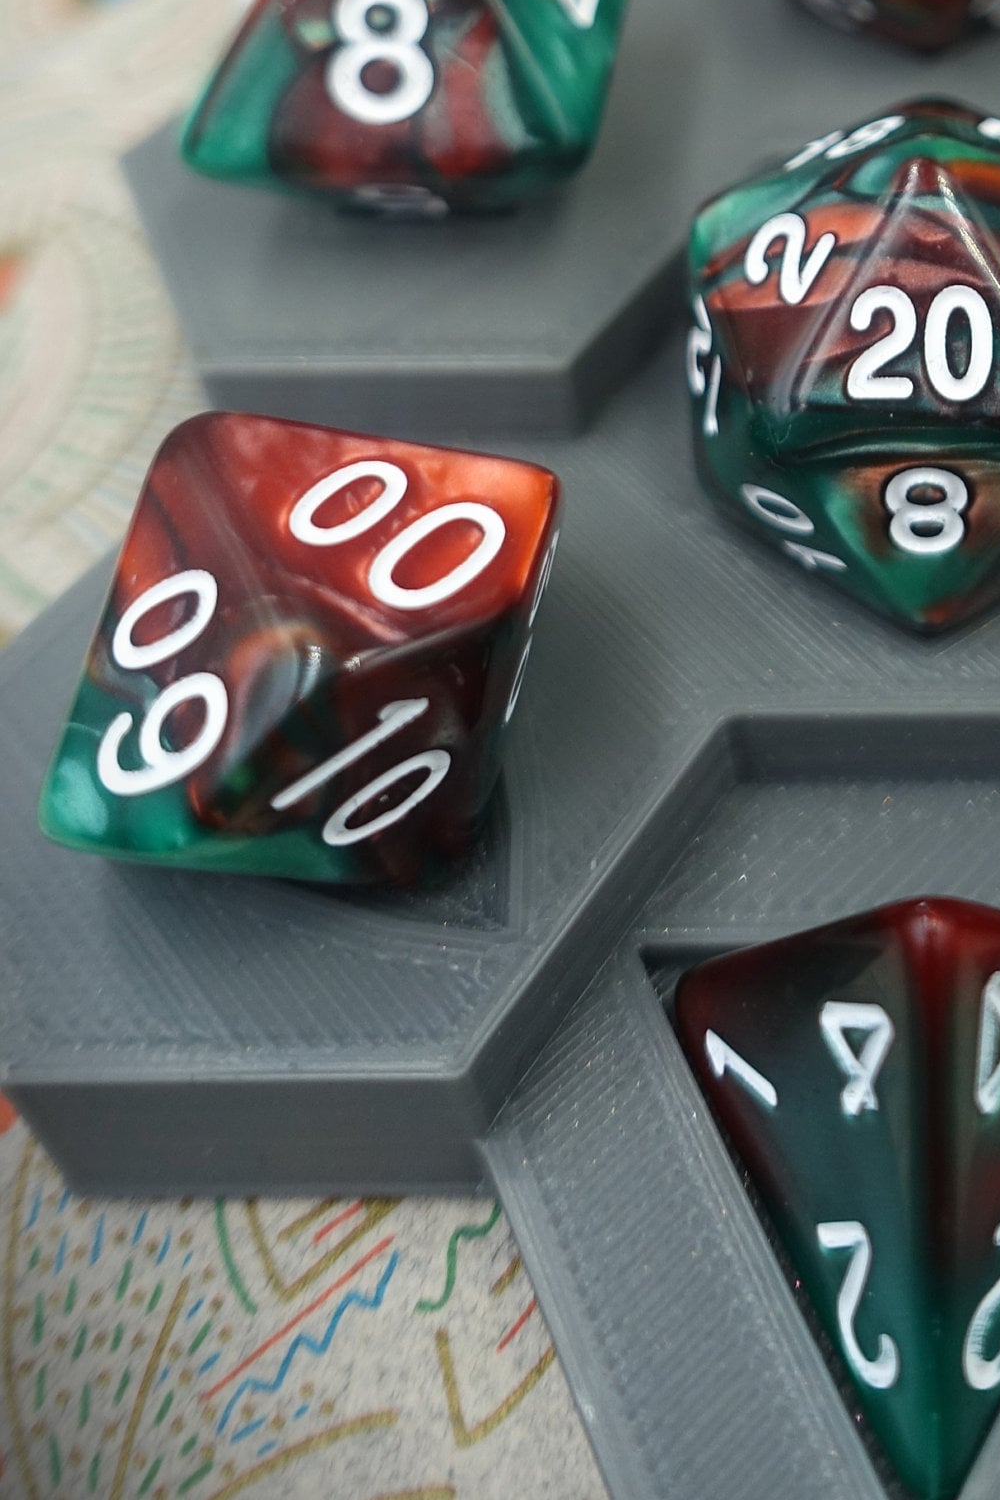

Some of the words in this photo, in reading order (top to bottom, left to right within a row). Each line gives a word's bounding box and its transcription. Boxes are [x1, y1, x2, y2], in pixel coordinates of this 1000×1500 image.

[746, 212, 835, 305] 2
[846, 284, 993, 402] 20
[289, 460, 506, 610] 00
[741, 483, 848, 573] 10
[885, 466, 968, 555] 8
[271, 697, 451, 846] 10
[705, 1029, 778, 1108] 1
[819, 1000, 895, 1116] 4
[816, 1220, 900, 1390] 2
